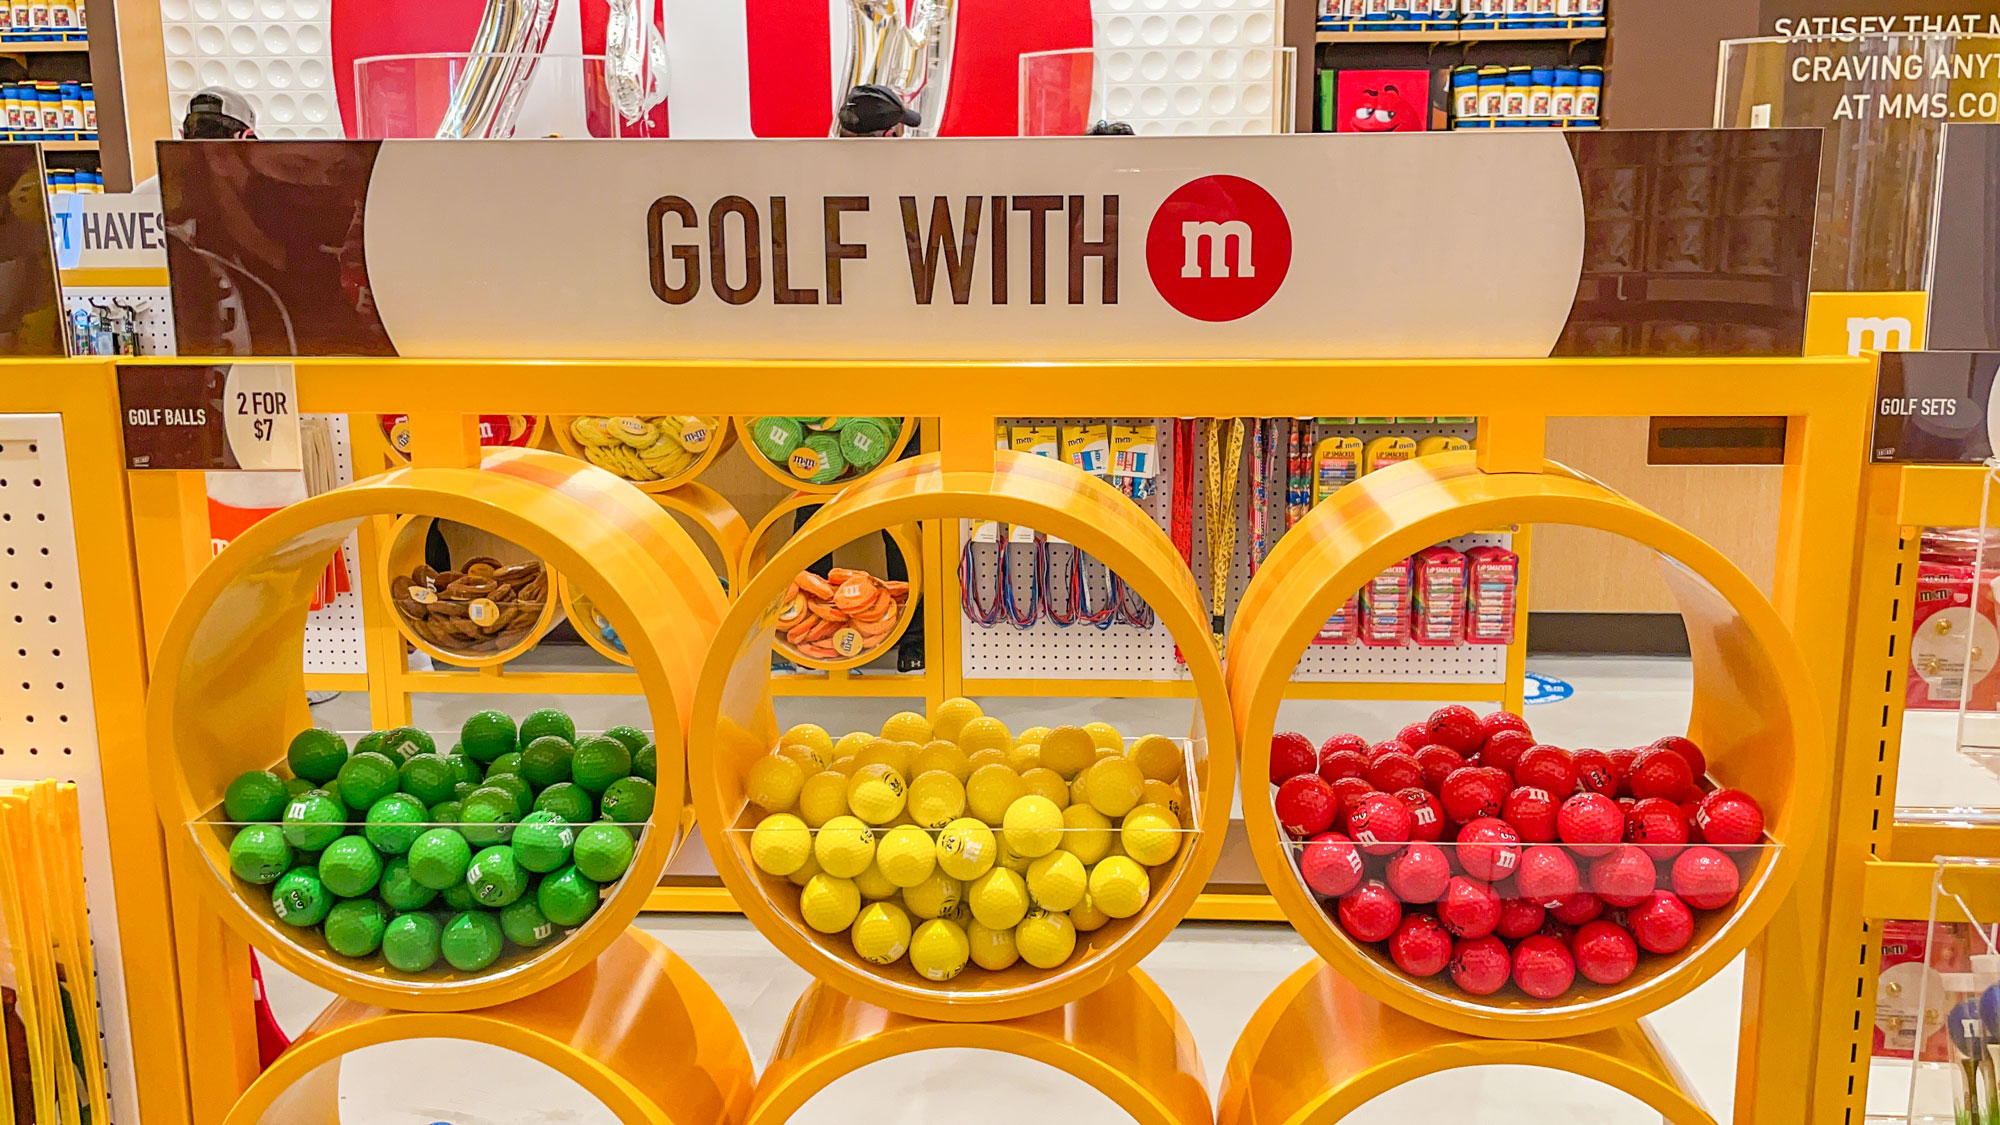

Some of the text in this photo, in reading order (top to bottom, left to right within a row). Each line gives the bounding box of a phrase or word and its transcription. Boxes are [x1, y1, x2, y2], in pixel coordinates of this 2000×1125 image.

[1775, 16, 1896, 43] SATISFY
[1904, 15, 1981, 40] THAT
[1792, 54, 1923, 82] CRAVING
[1832, 94, 1871, 120] AT
[647, 195, 1256, 305] GOLF WITH m
[237, 392, 289, 415] 2 FOR
[1881, 398, 1957, 415] GOLF SETS
[129, 408, 206, 426] GOLF BALLS
[254, 418, 273, 442] $7
[1415, 807, 1436, 825] m
[1496, 850, 1516, 868] m
